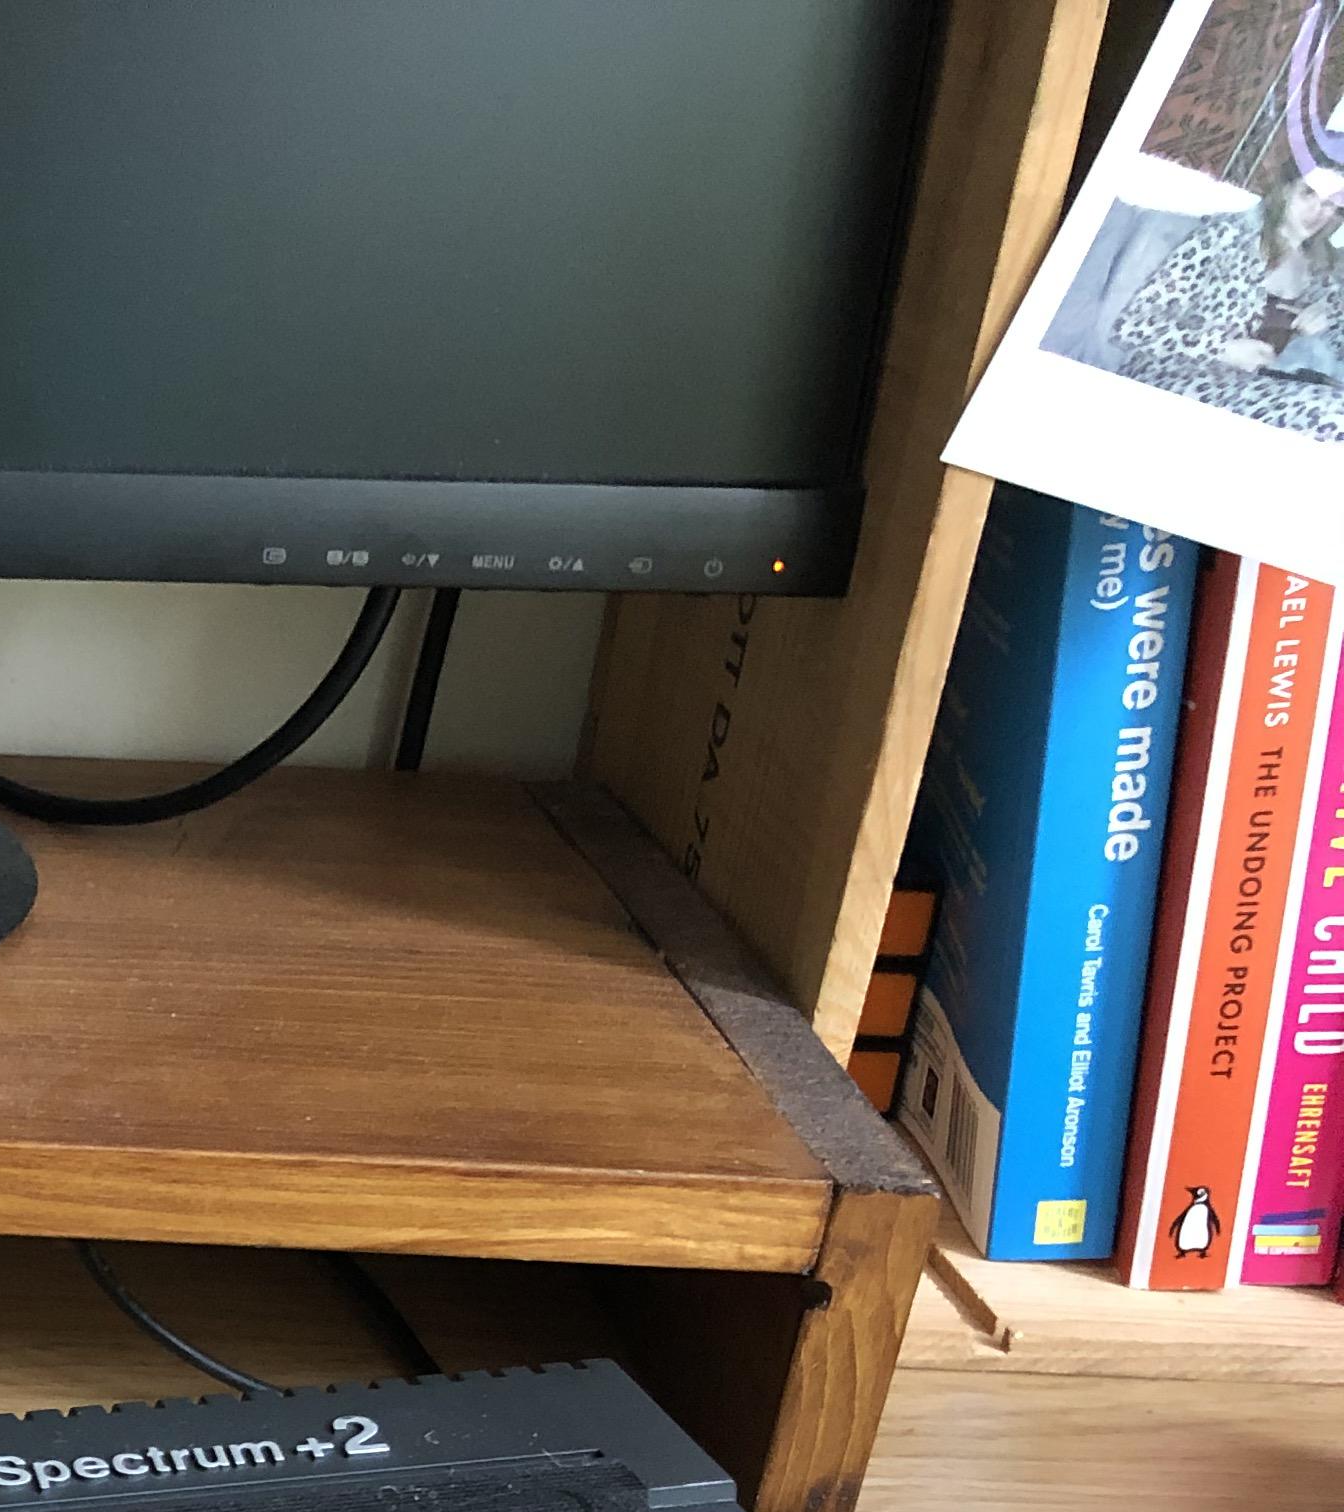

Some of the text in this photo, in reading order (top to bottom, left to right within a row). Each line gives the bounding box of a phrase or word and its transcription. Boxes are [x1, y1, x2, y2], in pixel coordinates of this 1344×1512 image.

[472, 553, 515, 570] MENU
[1089, 542, 1129, 610] me)
[1122, 585, 1170, 711] were
[1263, 574, 1309, 729] AEL LEWIS
[1104, 726, 1152, 862] made
[1209, 746, 1283, 1080] THE UNDOING PROJECT
[1059, 904, 1109, 1168] Carol Tavris and Elliot Aronson
[1286, 1083, 1328, 1189] EHRENSAFT
[293, 1414, 392, 1462] +2
